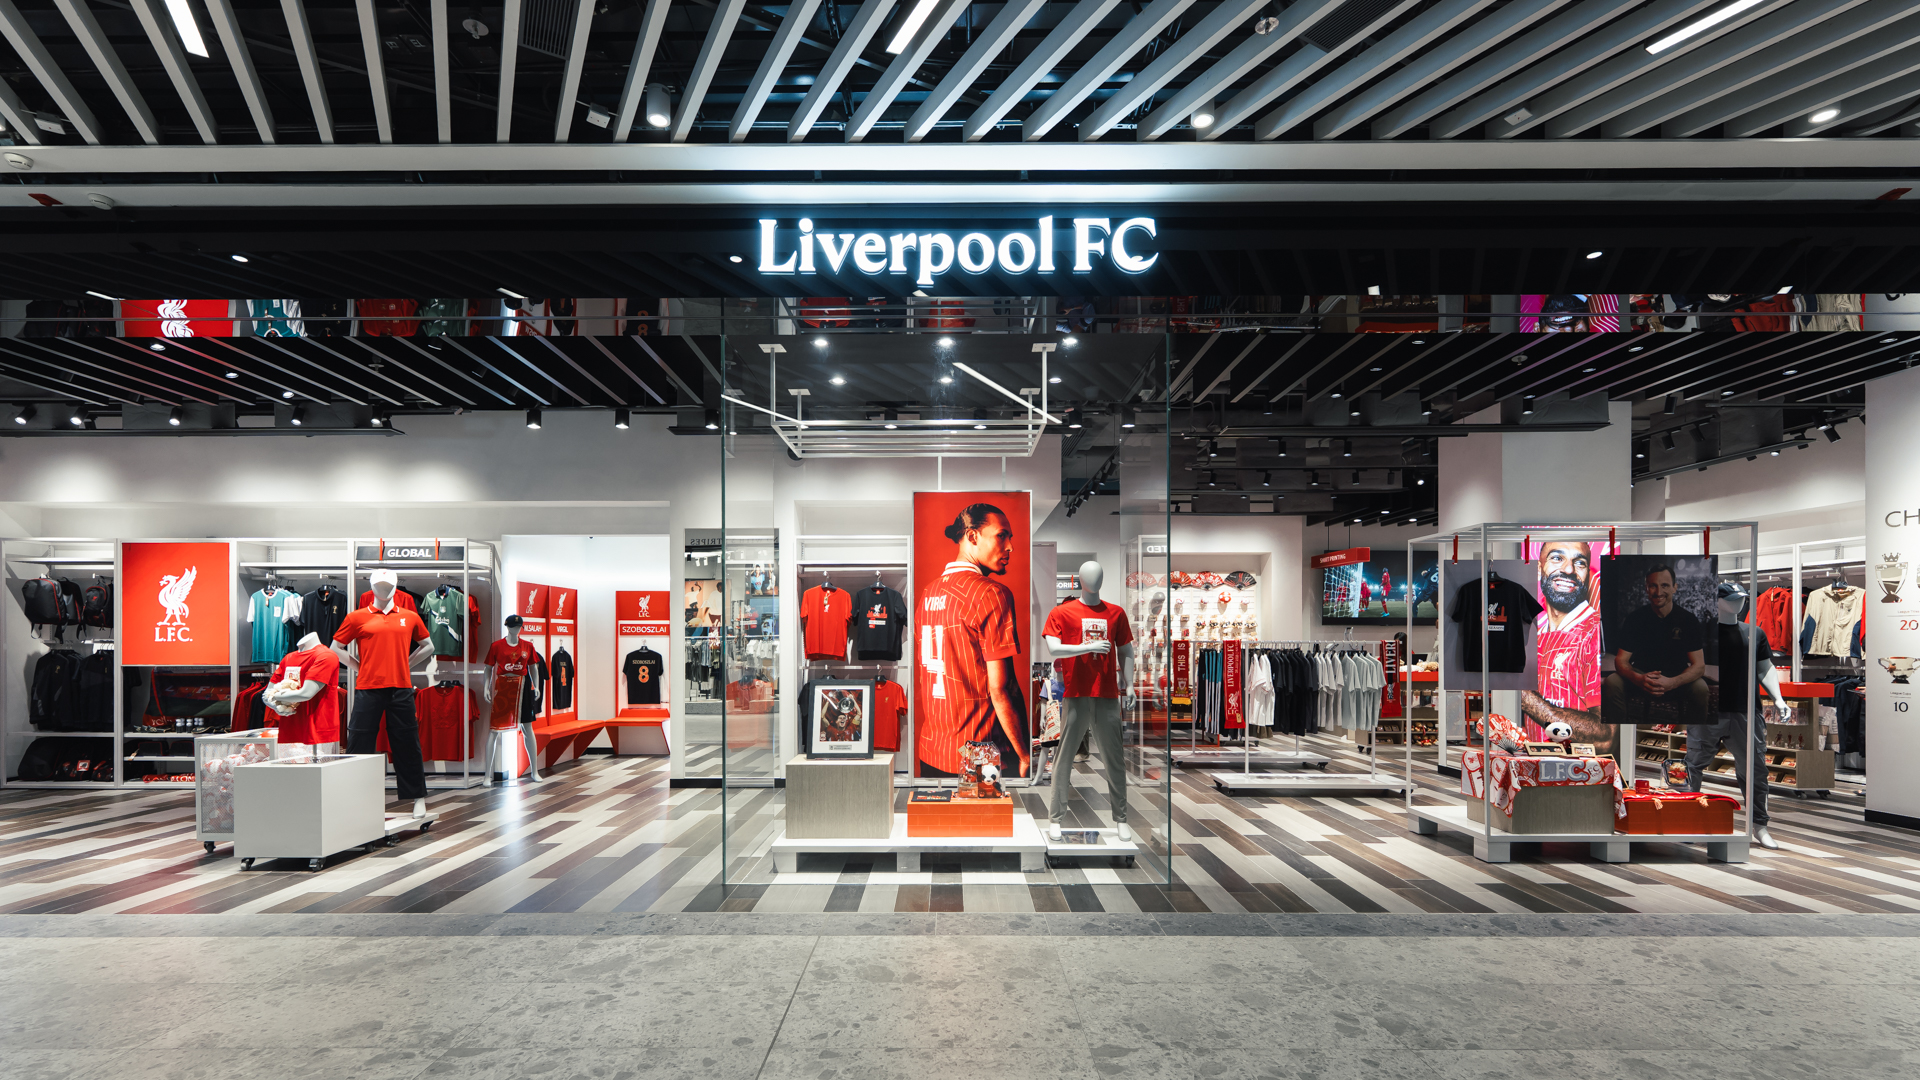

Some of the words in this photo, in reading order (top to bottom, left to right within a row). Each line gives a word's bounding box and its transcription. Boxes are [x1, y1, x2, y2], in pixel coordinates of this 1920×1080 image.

[758, 215, 1056, 288] Liverpool
[1073, 217, 1160, 275] FC
[387, 548, 432, 558] GLOBAL
[1430, 572, 1439, 583] 6
[1899, 620, 1919, 631] 20
[154, 627, 194, 642] L.F.C.
[1177, 642, 1186, 650] IS
[1227, 643, 1235, 652] FC
[921, 624, 946, 699] 4
[1177, 654, 1186, 672] THIS
[638, 665, 650, 683] 8
[1227, 653, 1235, 687] LIVERPOOL
[1893, 701, 1909, 713] 10
[1540, 762, 1587, 780] L.F.C.
